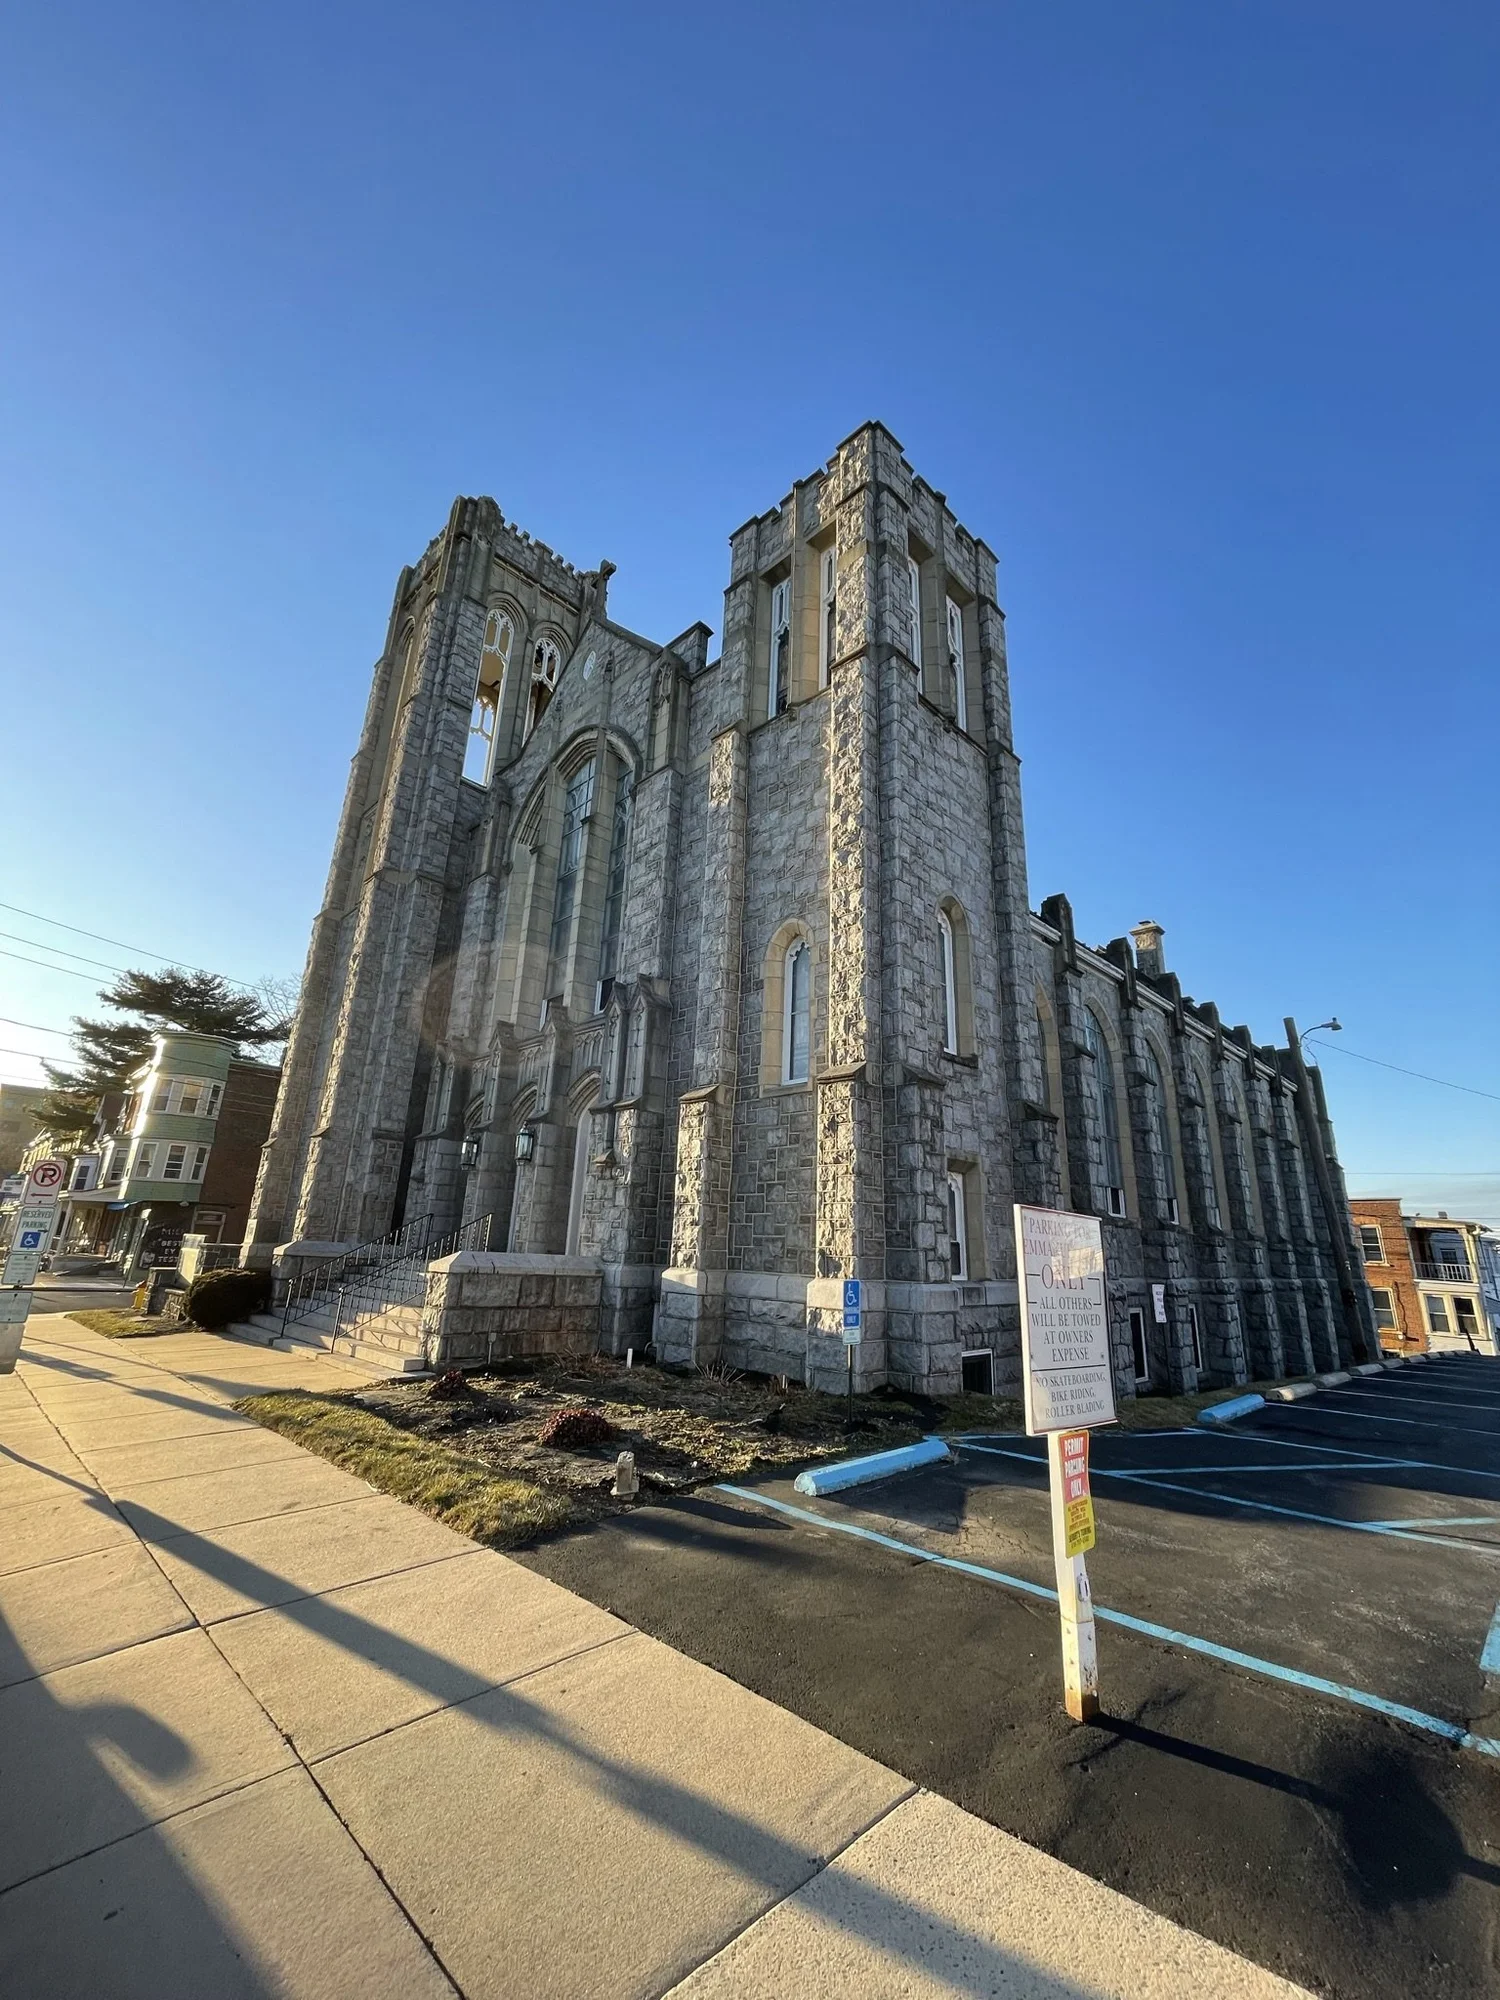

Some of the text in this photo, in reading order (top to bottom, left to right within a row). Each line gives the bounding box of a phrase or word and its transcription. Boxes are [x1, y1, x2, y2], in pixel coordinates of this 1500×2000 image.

[23, 1210, 53, 1219] RESERVED
[21, 1220, 48, 1229] PARKING
[1029, 1217, 1071, 1237] PARKING
[1042, 1264, 1085, 1290] ONLY
[1040, 1296, 1093, 1310] ALL OTHERS
[1031, 1313, 1101, 1327] WILL BE TOWED
[1044, 1330, 1094, 1345] AT OWNERS
[1052, 1347, 1090, 1362] EXPENSE
[1035, 1376, 1048, 1387] NO
[1051, 1389, 1069, 1402] BIKE
[1045, 1400, 1105, 1419] ROLLER BLADING
[1065, 1456, 1085, 1479] PARKING
